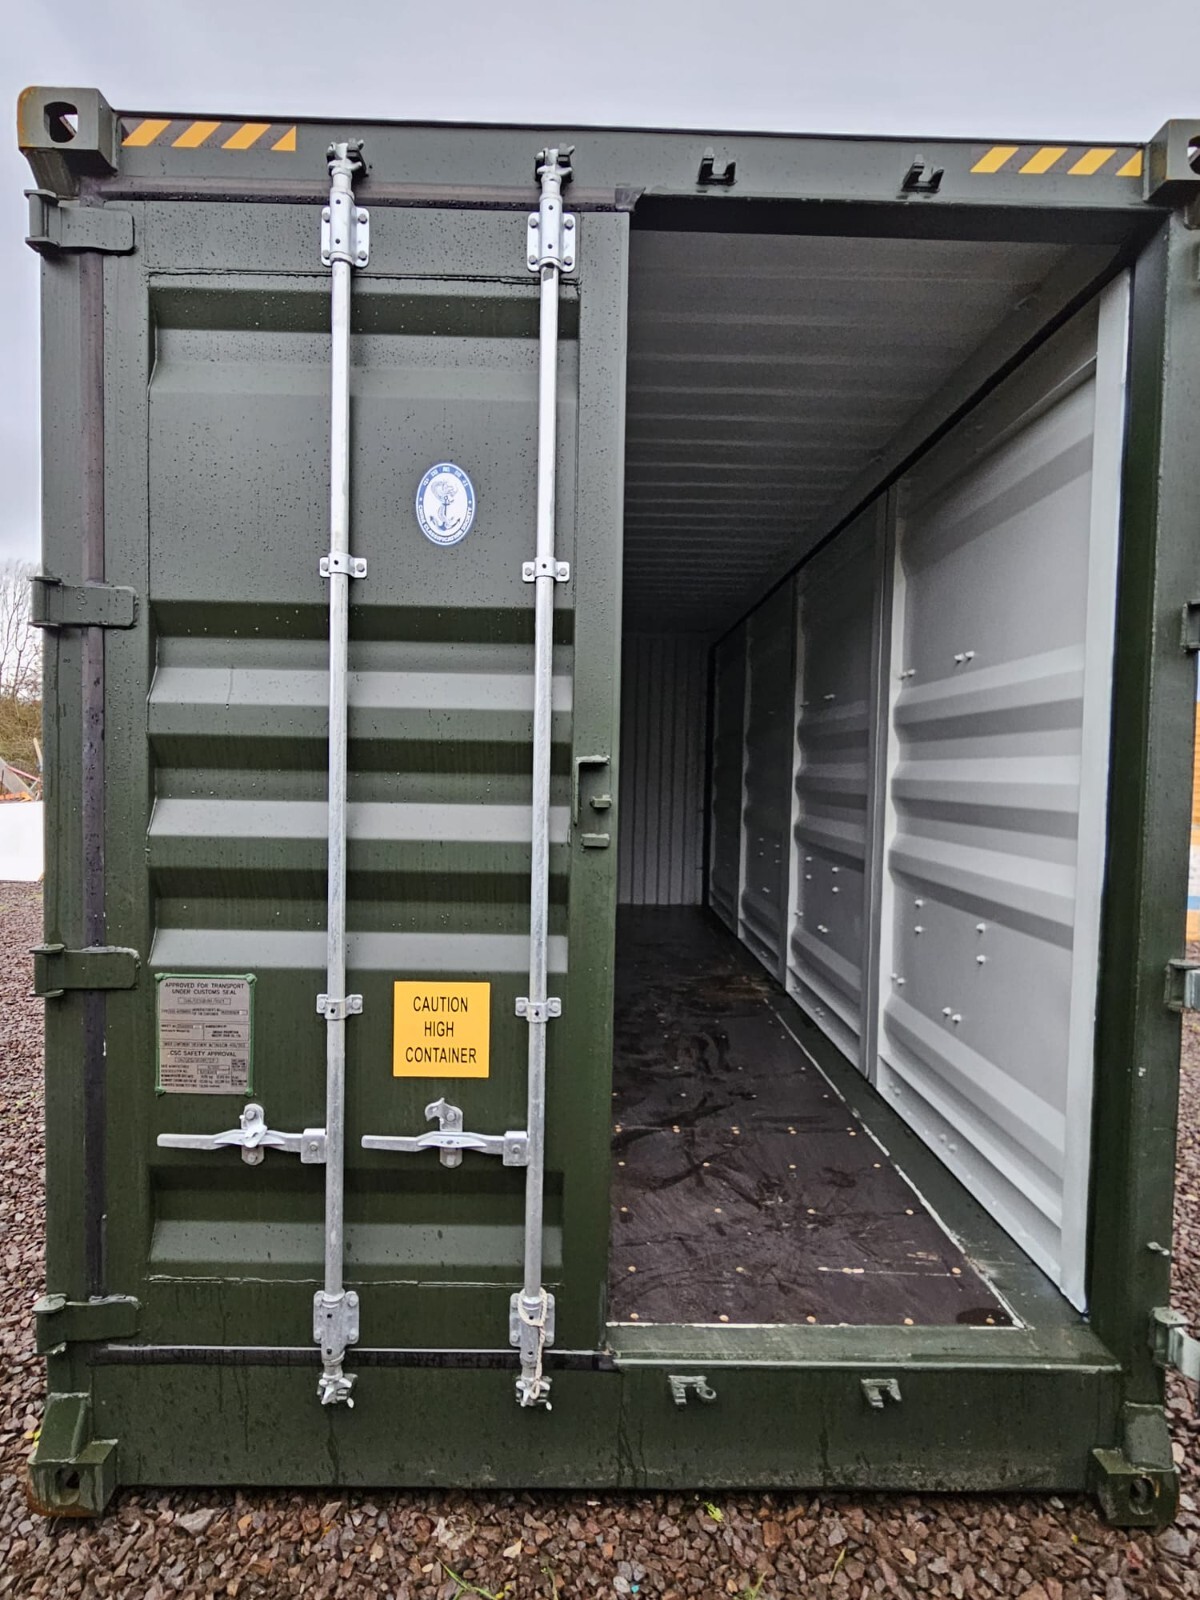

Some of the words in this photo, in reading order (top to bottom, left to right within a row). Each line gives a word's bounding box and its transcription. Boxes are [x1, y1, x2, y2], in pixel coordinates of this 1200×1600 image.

[413, 996, 468, 1012] CAUTION
[424, 1021, 454, 1037] HIGH
[405, 1047, 477, 1063] CONTAINER
